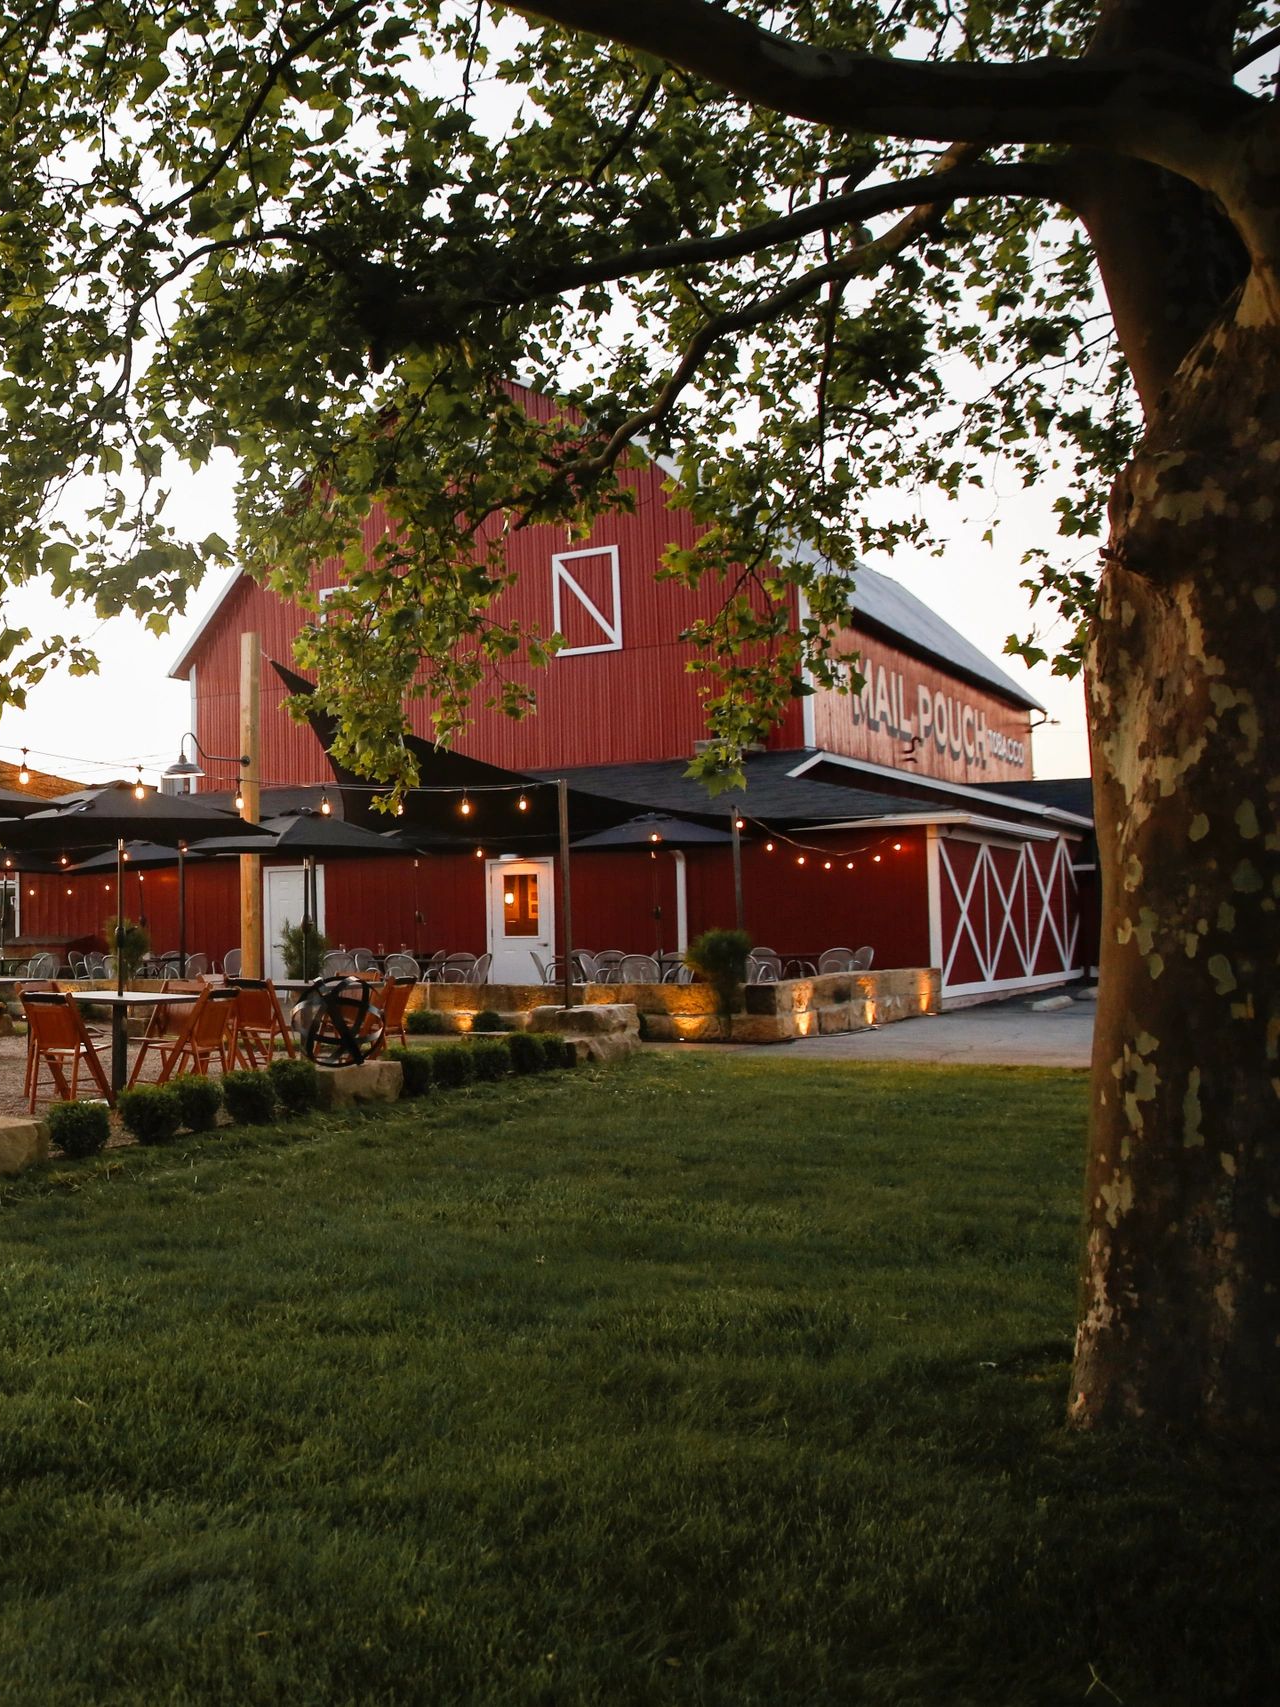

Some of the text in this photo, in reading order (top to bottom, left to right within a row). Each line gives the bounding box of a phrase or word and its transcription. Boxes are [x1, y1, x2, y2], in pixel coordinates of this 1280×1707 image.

[852, 659, 1024, 768] MAIL POUCH TOBACCO
